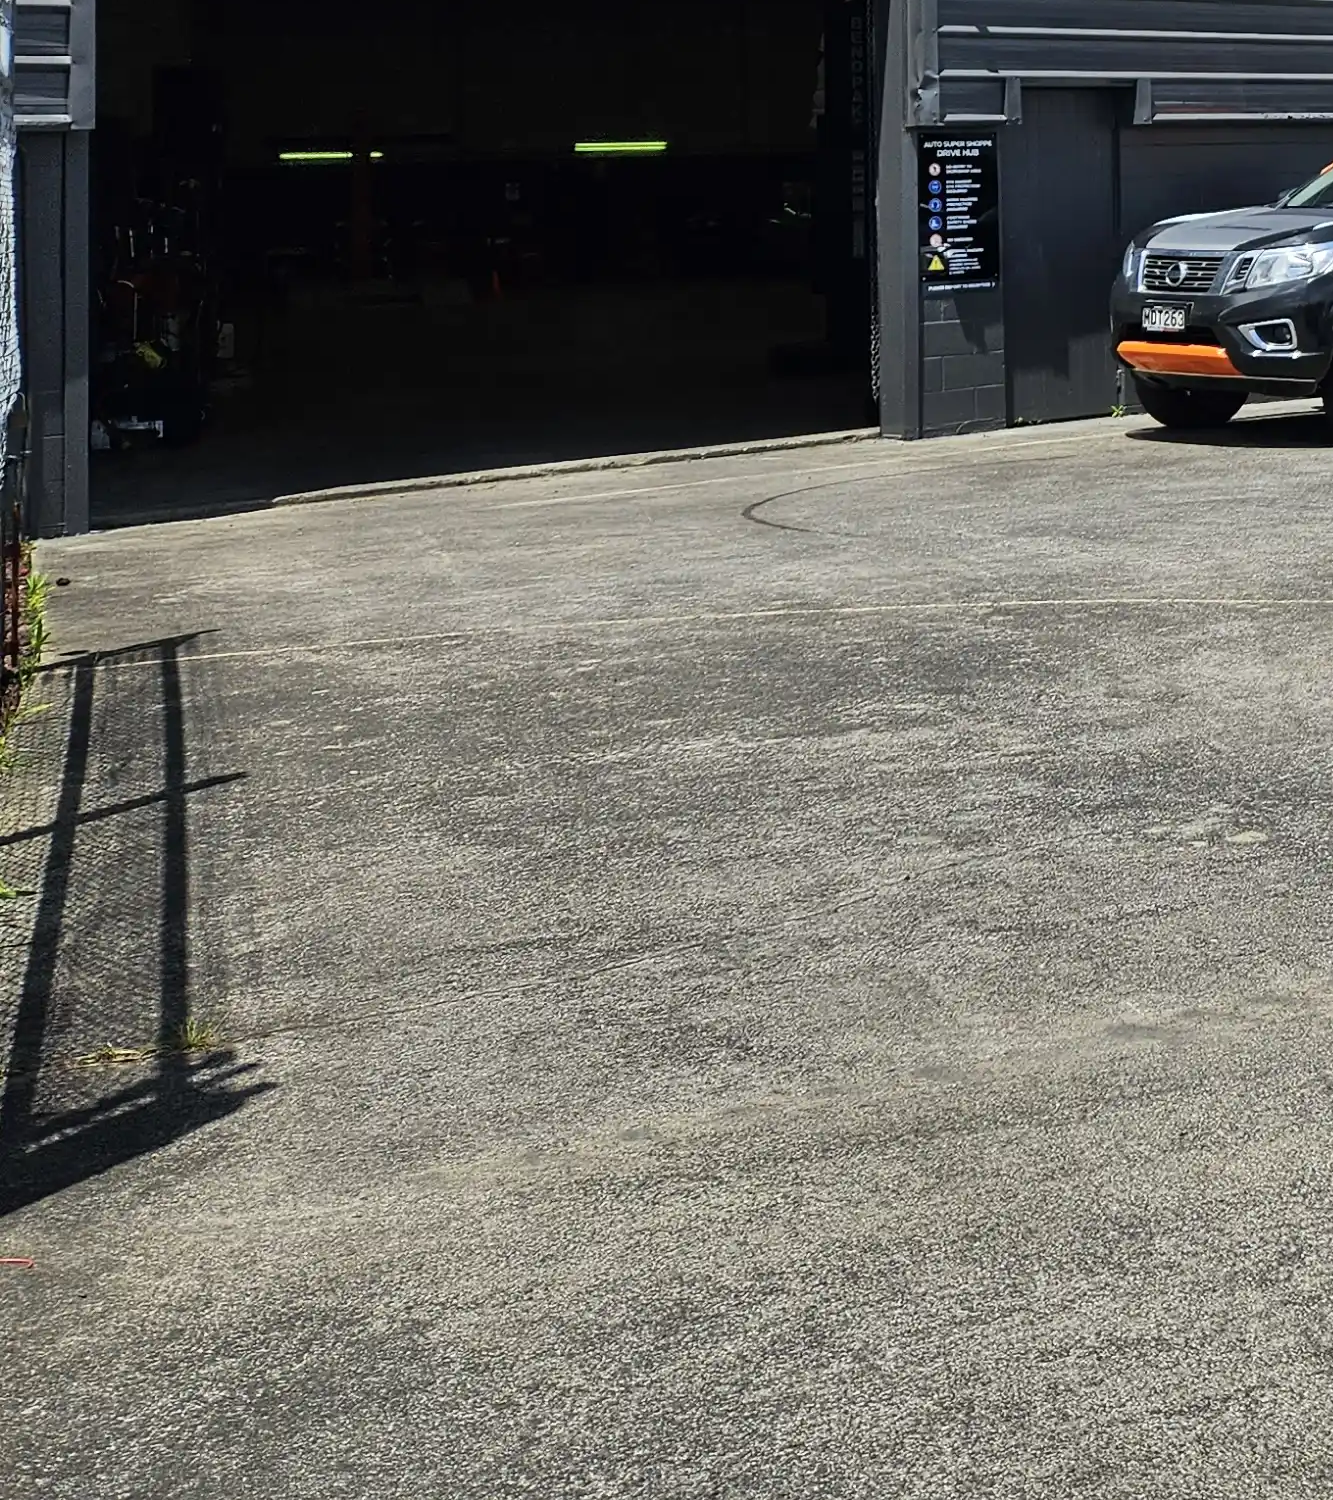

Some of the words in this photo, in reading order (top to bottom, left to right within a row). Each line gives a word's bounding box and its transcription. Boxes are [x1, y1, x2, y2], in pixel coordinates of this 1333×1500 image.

[924, 140, 943, 149] AUTO
[943, 140, 965, 148] SUPER
[966, 139, 992, 147] SHOPPE
[936, 149, 961, 157] DRIVE
[962, 148, 979, 157] HUB
